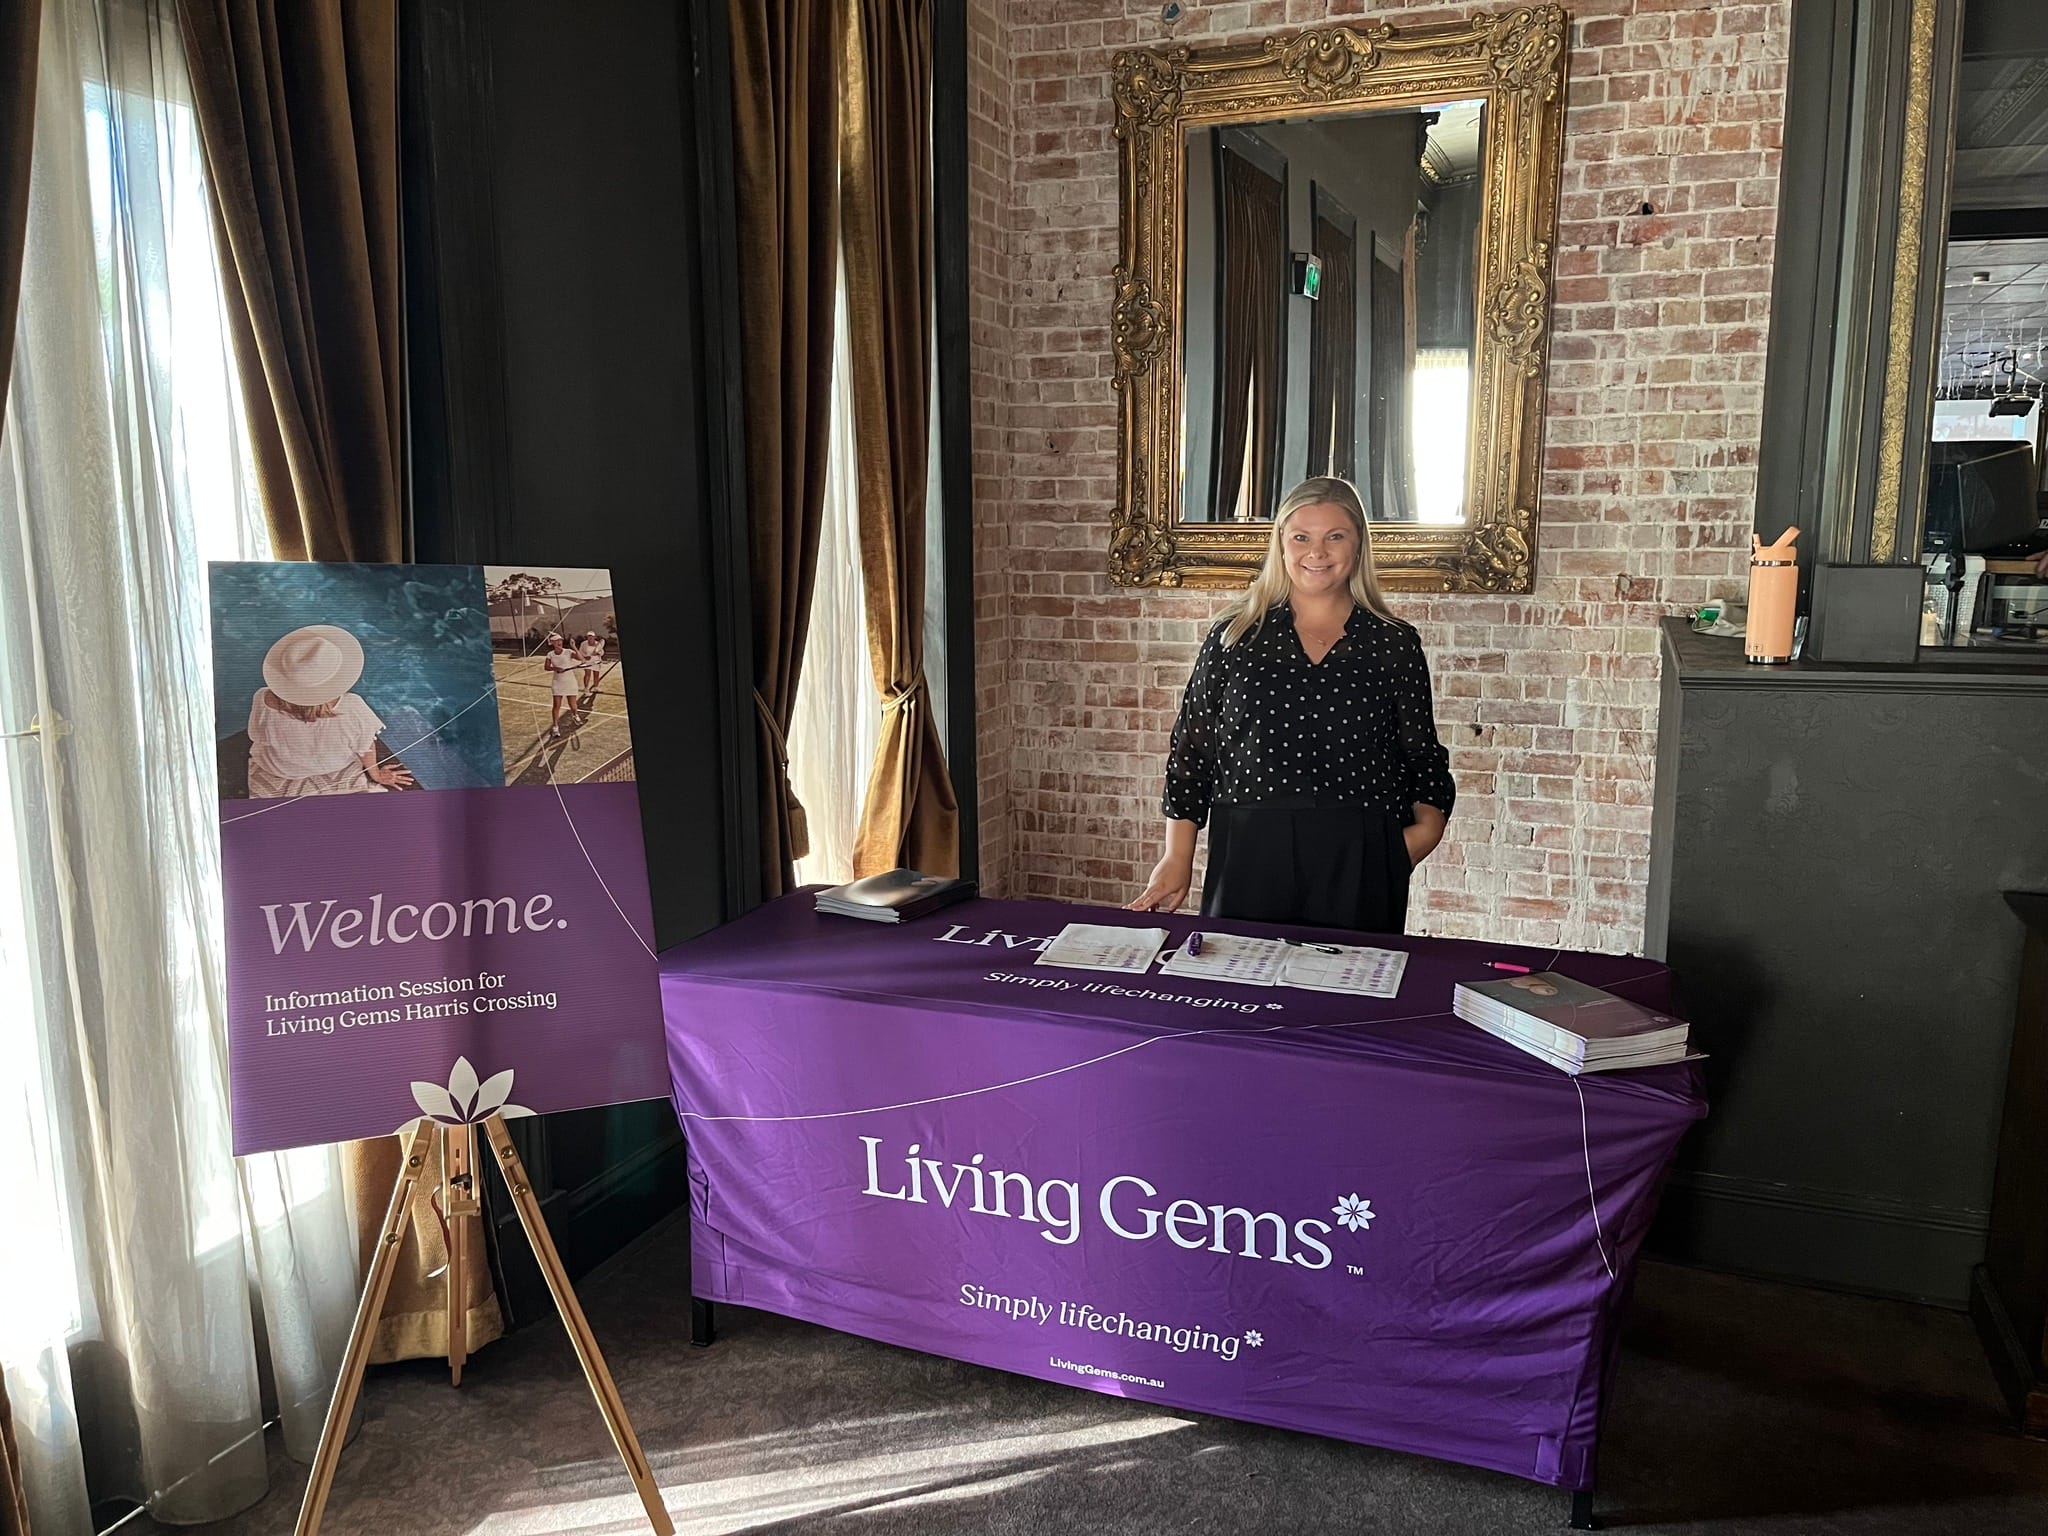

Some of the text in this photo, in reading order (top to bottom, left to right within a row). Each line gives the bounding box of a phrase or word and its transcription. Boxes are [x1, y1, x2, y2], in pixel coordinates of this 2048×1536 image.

[260, 893, 568, 955] Welcome.
[933, 924, 1055, 952] Livi
[265, 972, 506, 1012] Information Session for
[266, 991, 557, 1036] Living Gems Harris Crossing
[983, 972, 1260, 1014] Simply lifechanging
[859, 1136, 1332, 1269] Living Gems
[959, 1284, 1240, 1361] Simply lifechanging
[1049, 1356, 1165, 1388] LivingGems.com.au
